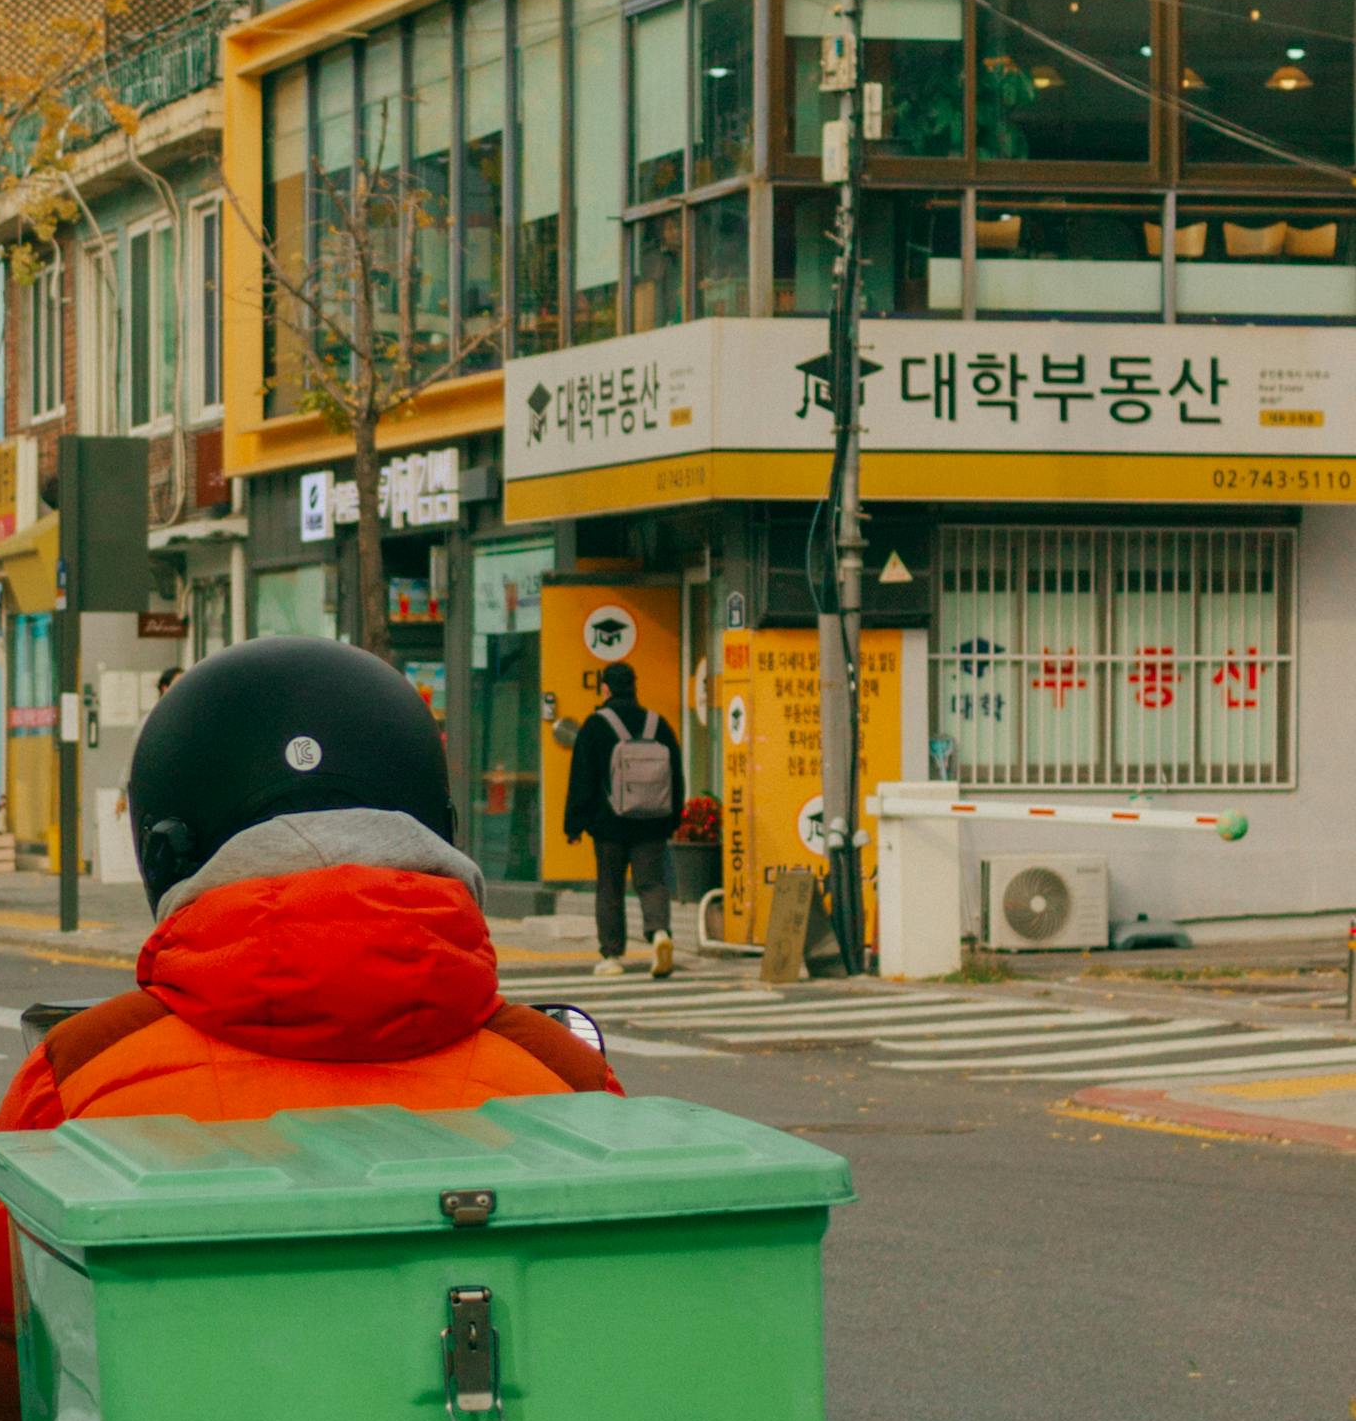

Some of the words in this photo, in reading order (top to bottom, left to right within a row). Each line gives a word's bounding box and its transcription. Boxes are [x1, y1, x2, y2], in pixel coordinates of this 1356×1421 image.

[556, 361, 660, 444] 대학부동산
[899, 352, 1230, 425] 대학부동산
[1031, 645, 1266, 709] 부동산
[727, 752, 747, 778] 대학
[730, 787, 745, 916] 부동산
